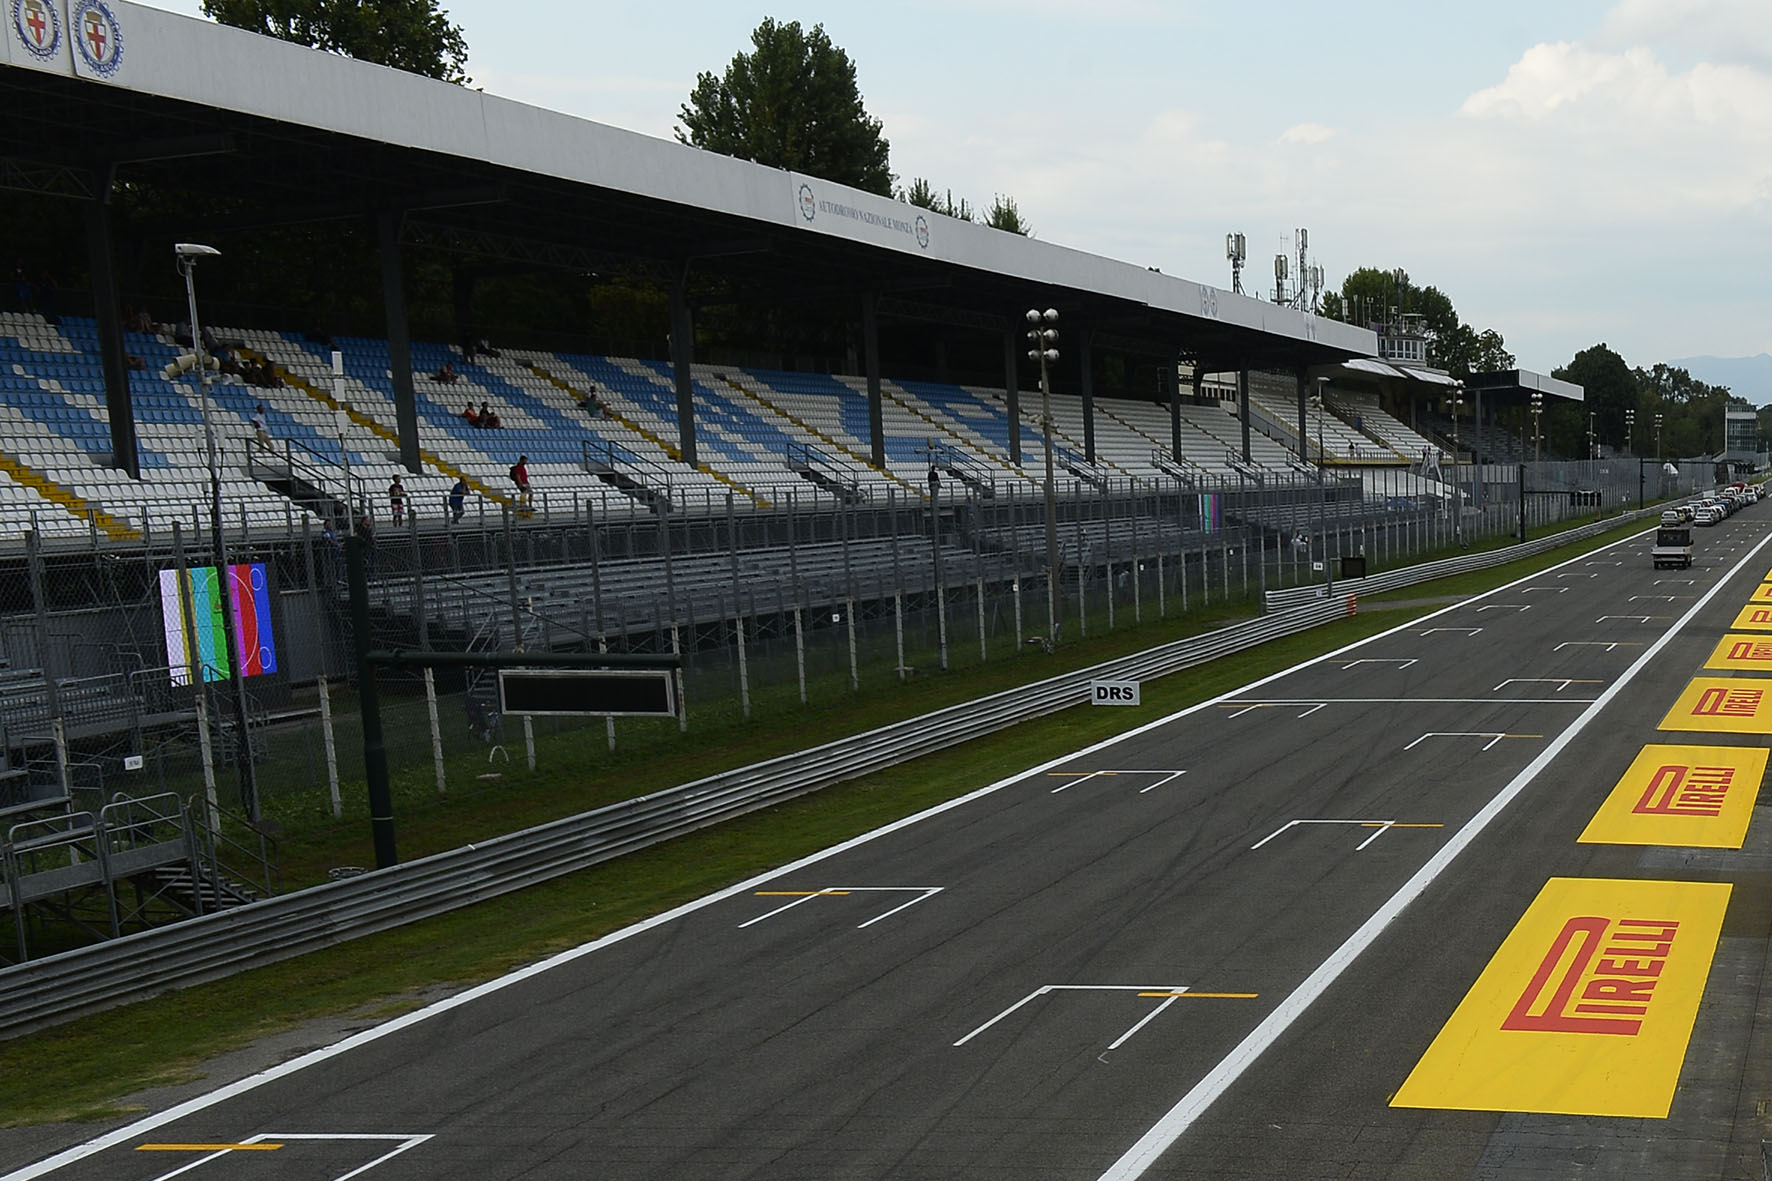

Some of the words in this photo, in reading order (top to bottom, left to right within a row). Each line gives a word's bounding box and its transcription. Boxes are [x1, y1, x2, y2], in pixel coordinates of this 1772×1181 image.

[1096, 685, 1134, 700] DRS
[1691, 688, 1763, 717] PIRELLI
[1632, 765, 1735, 816] PIRELLI
[1500, 916, 1680, 1036] PIRELLI
